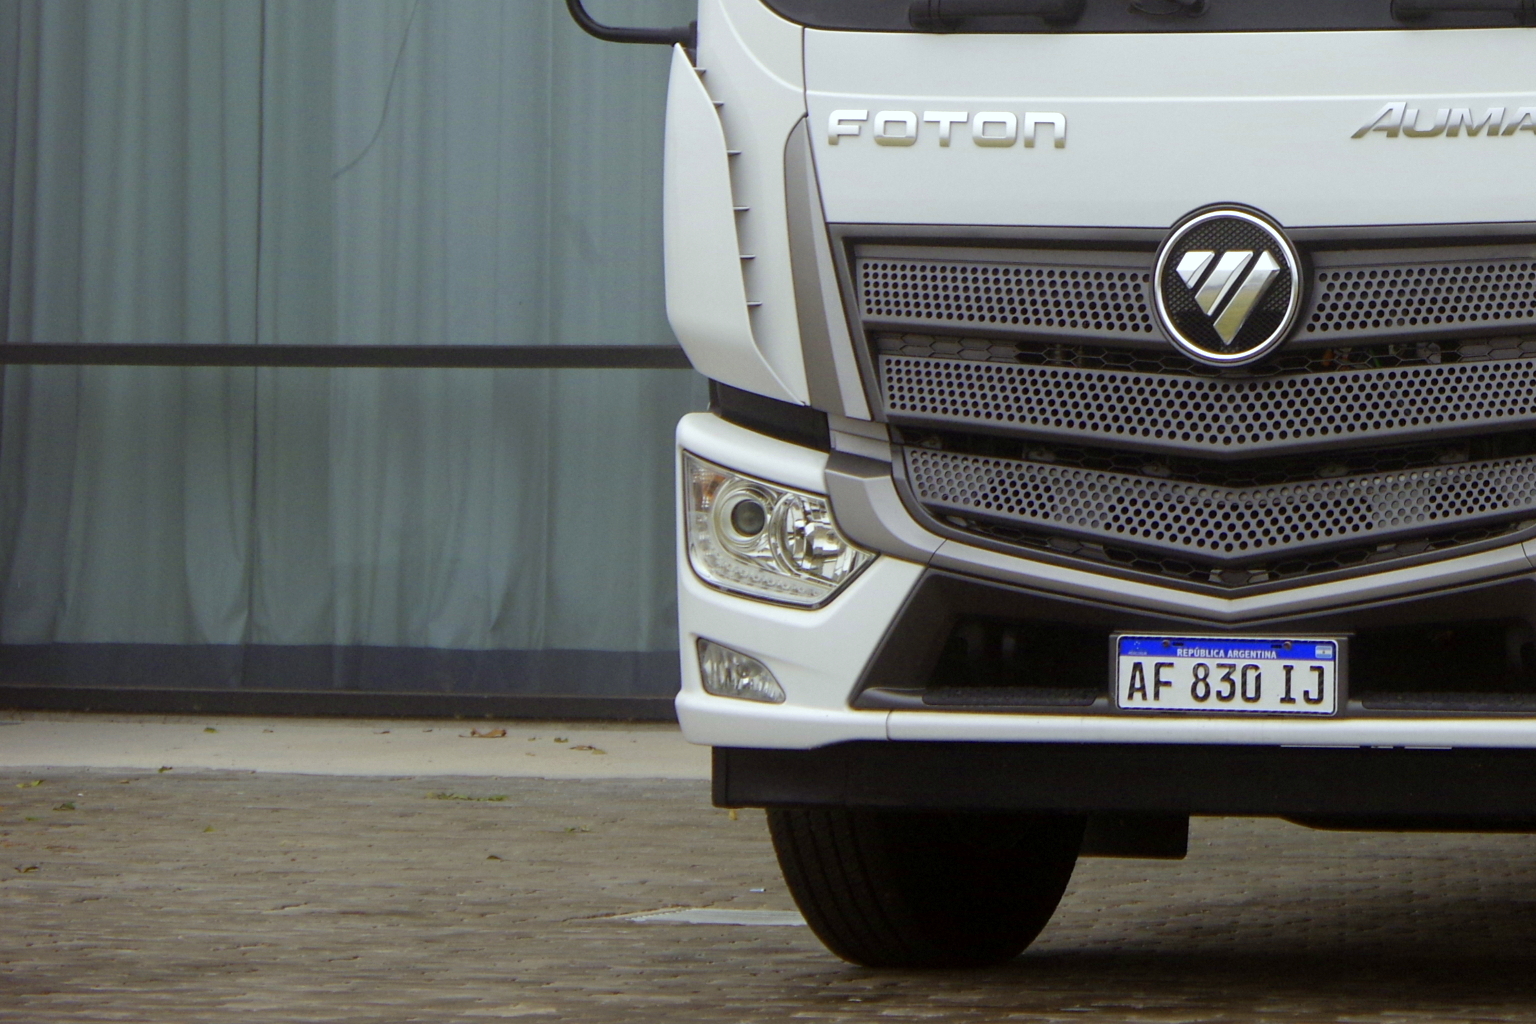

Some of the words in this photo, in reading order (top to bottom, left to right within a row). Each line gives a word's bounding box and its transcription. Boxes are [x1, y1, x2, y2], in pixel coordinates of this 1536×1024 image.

[828, 109, 1066, 149] FOTON
[1177, 647, 1225, 658] REPÚBLICA
[1227, 649, 1277, 659] ARGENTINA
[1127, 662, 1174, 701] AF
[1190, 662, 1262, 704] 830
[1280, 665, 1324, 705] IJ
